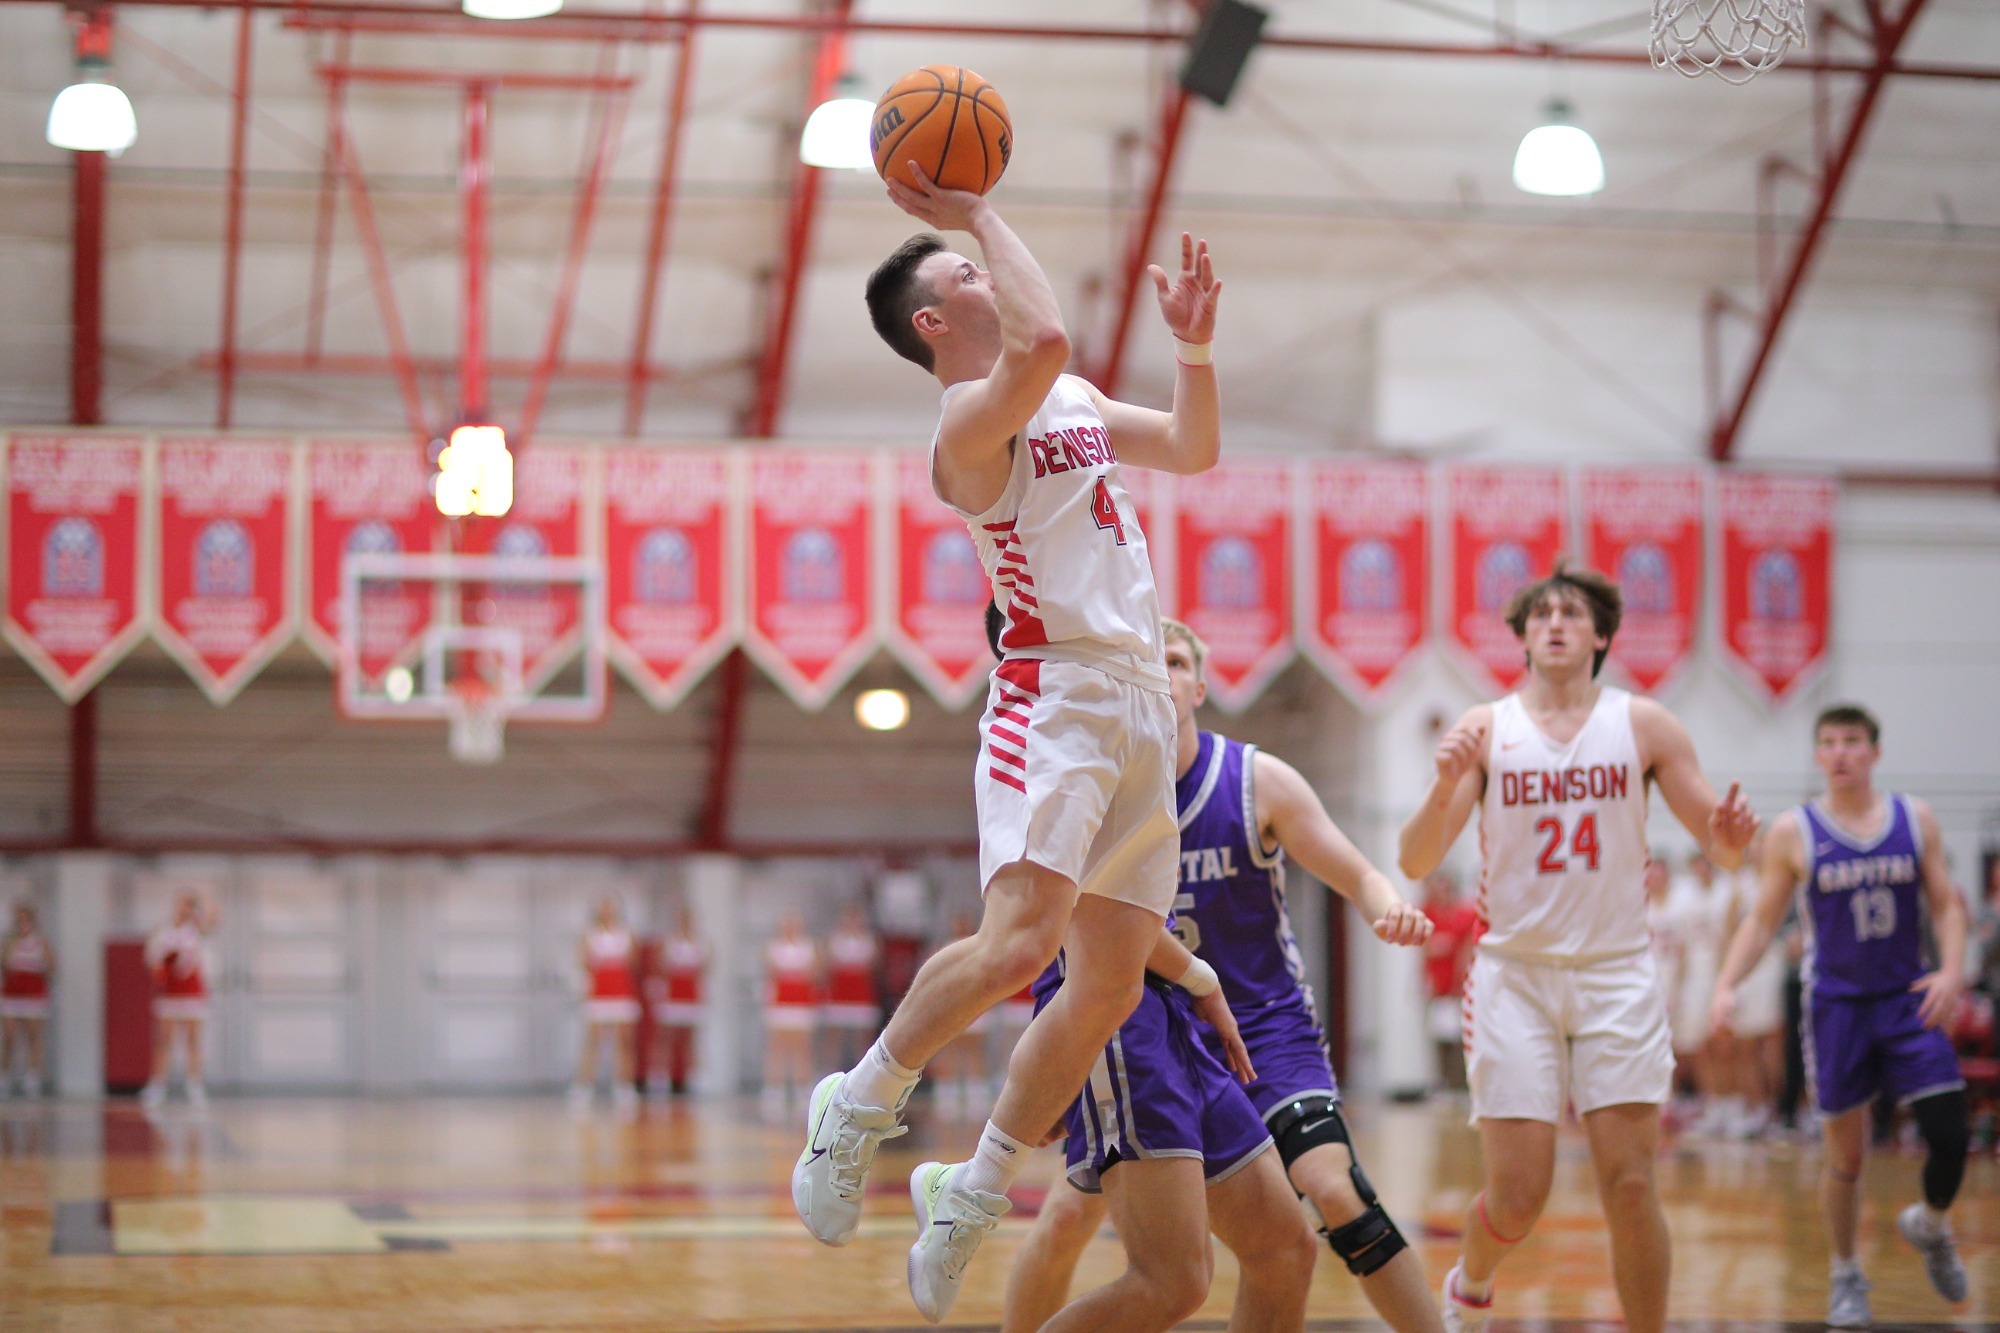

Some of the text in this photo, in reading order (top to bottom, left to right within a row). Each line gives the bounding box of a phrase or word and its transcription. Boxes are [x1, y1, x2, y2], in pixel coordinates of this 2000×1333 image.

[1090, 475, 1127, 546] 4
[1503, 764, 1628, 806] DENISON
[1178, 846, 1239, 884] TAL
[1535, 811, 1600, 874] 24
[1850, 886, 1897, 942] 13
